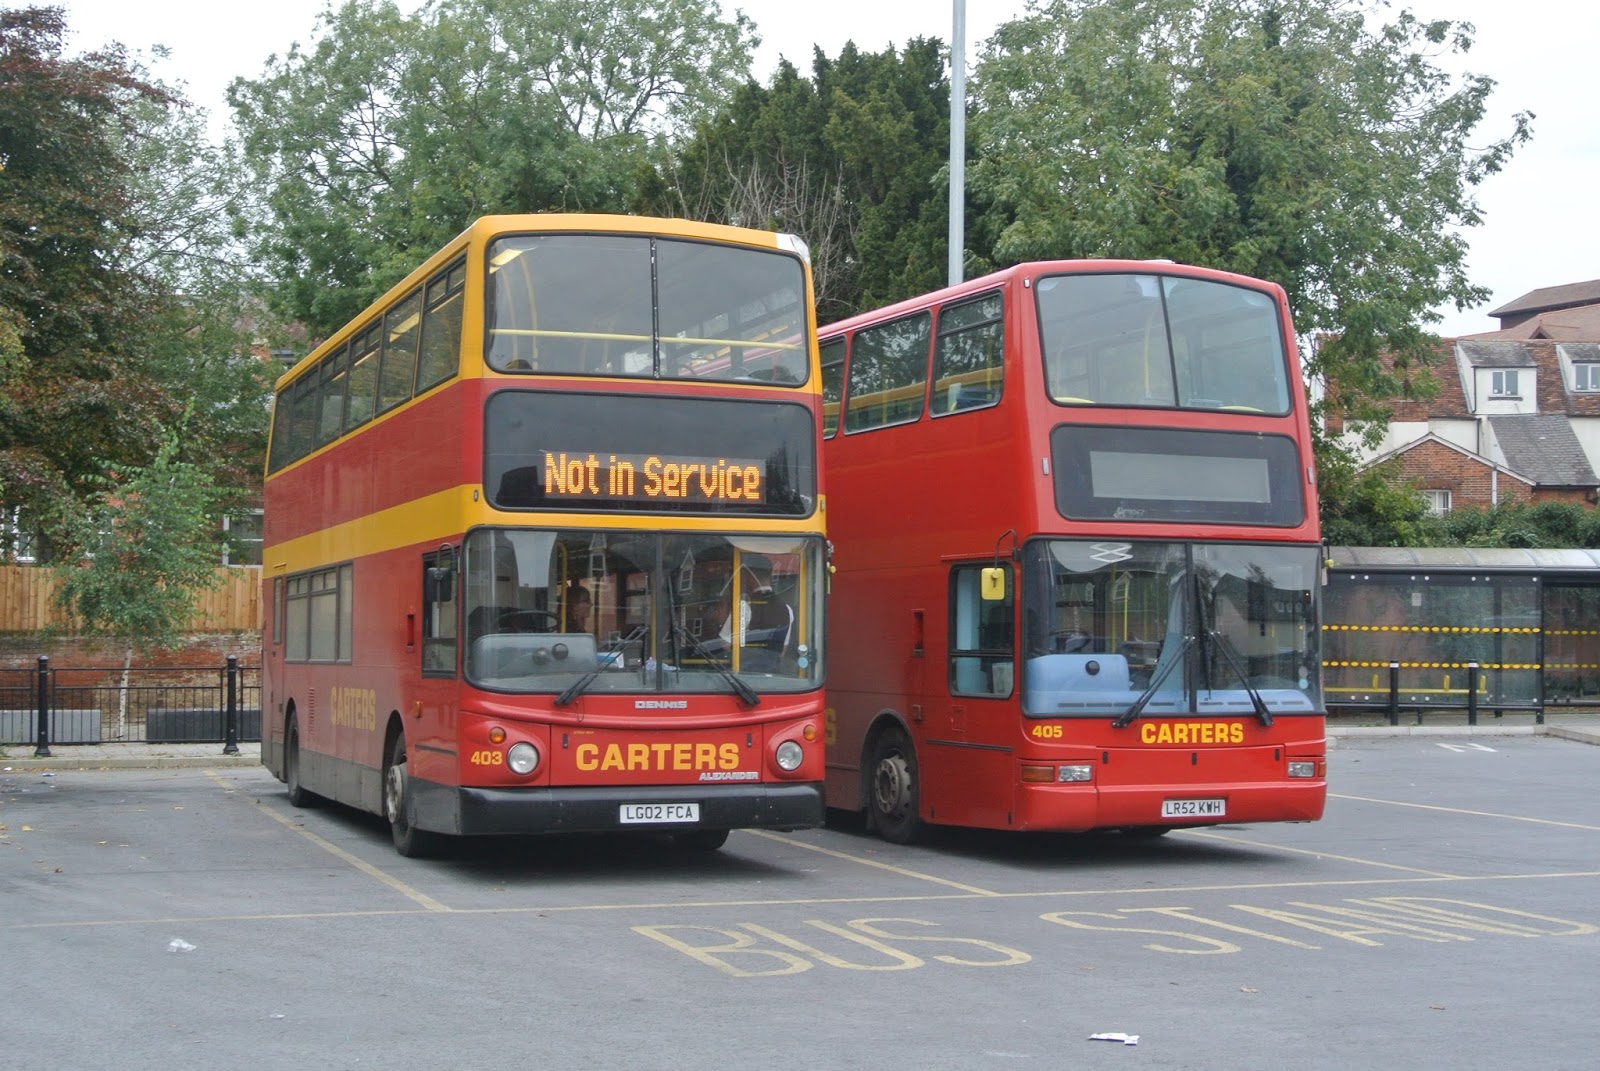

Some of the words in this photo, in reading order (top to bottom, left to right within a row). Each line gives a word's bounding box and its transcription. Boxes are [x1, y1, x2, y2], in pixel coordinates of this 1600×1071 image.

[544, 453, 600, 495] Not
[609, 456, 634, 496] in
[643, 456, 761, 500] Service
[330, 686, 376, 732] CARTERS
[634, 700, 688, 710] DENNIS
[1032, 725, 1063, 738] 405
[1141, 723, 1244, 744] CARTERS
[470, 751, 503, 766] 403
[576, 743, 740, 771] CARTERS
[699, 771, 759, 781] ALEXANDER
[626, 805, 663, 820] LG02
[667, 805, 693, 820] FCA
[1166, 802, 1196, 815] LR52
[1199, 801, 1221, 814] KWH
[631, 917, 1032, 977] BUS
[1039, 896, 1598, 955] STAND
